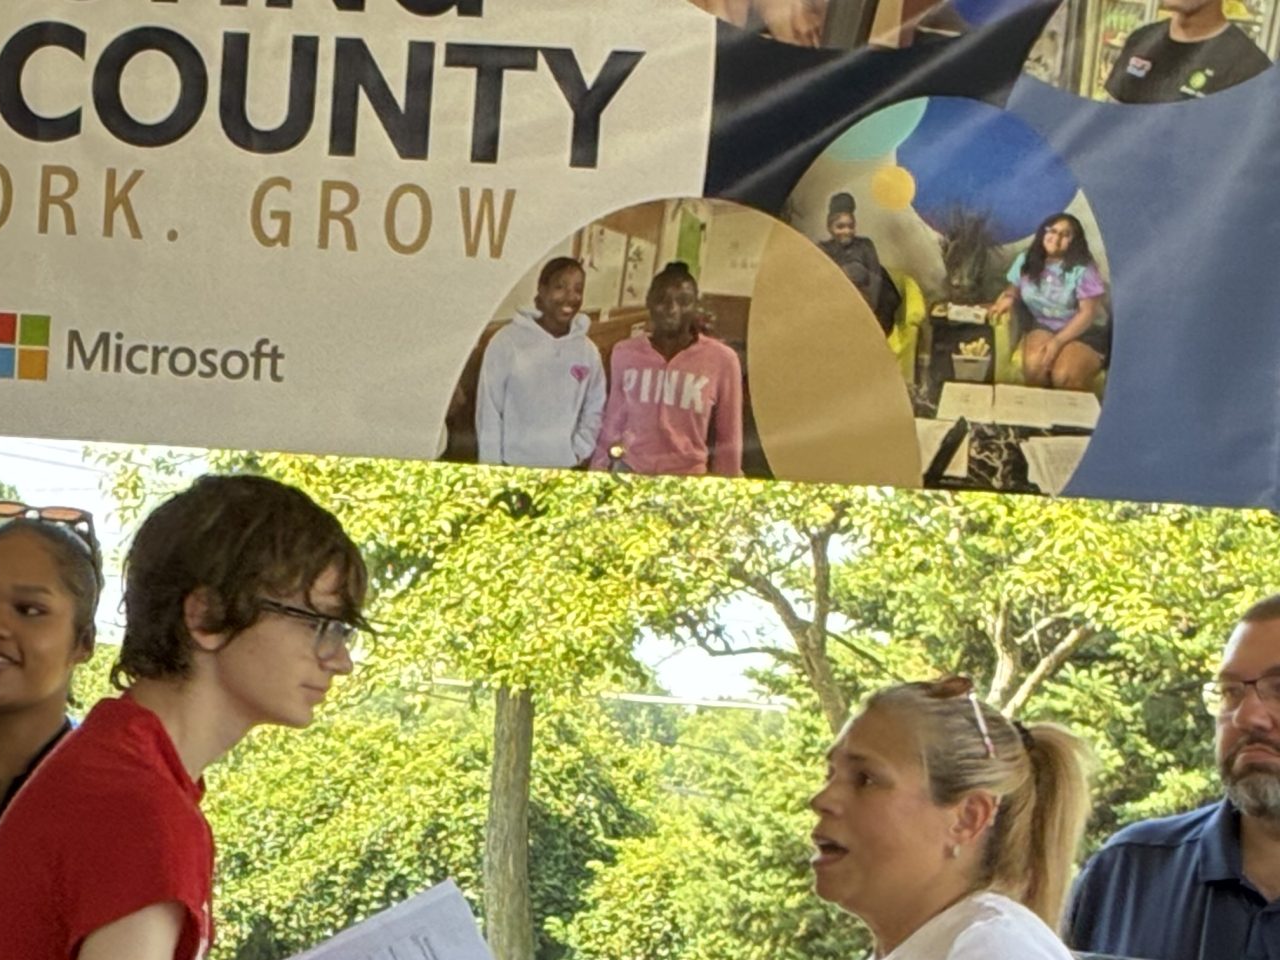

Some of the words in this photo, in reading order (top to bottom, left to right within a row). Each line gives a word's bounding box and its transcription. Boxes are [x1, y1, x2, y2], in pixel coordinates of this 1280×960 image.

[250, 176, 517, 259] GROW
[66, 329, 285, 382] Microsoft
[623, 367, 710, 414] PINK
